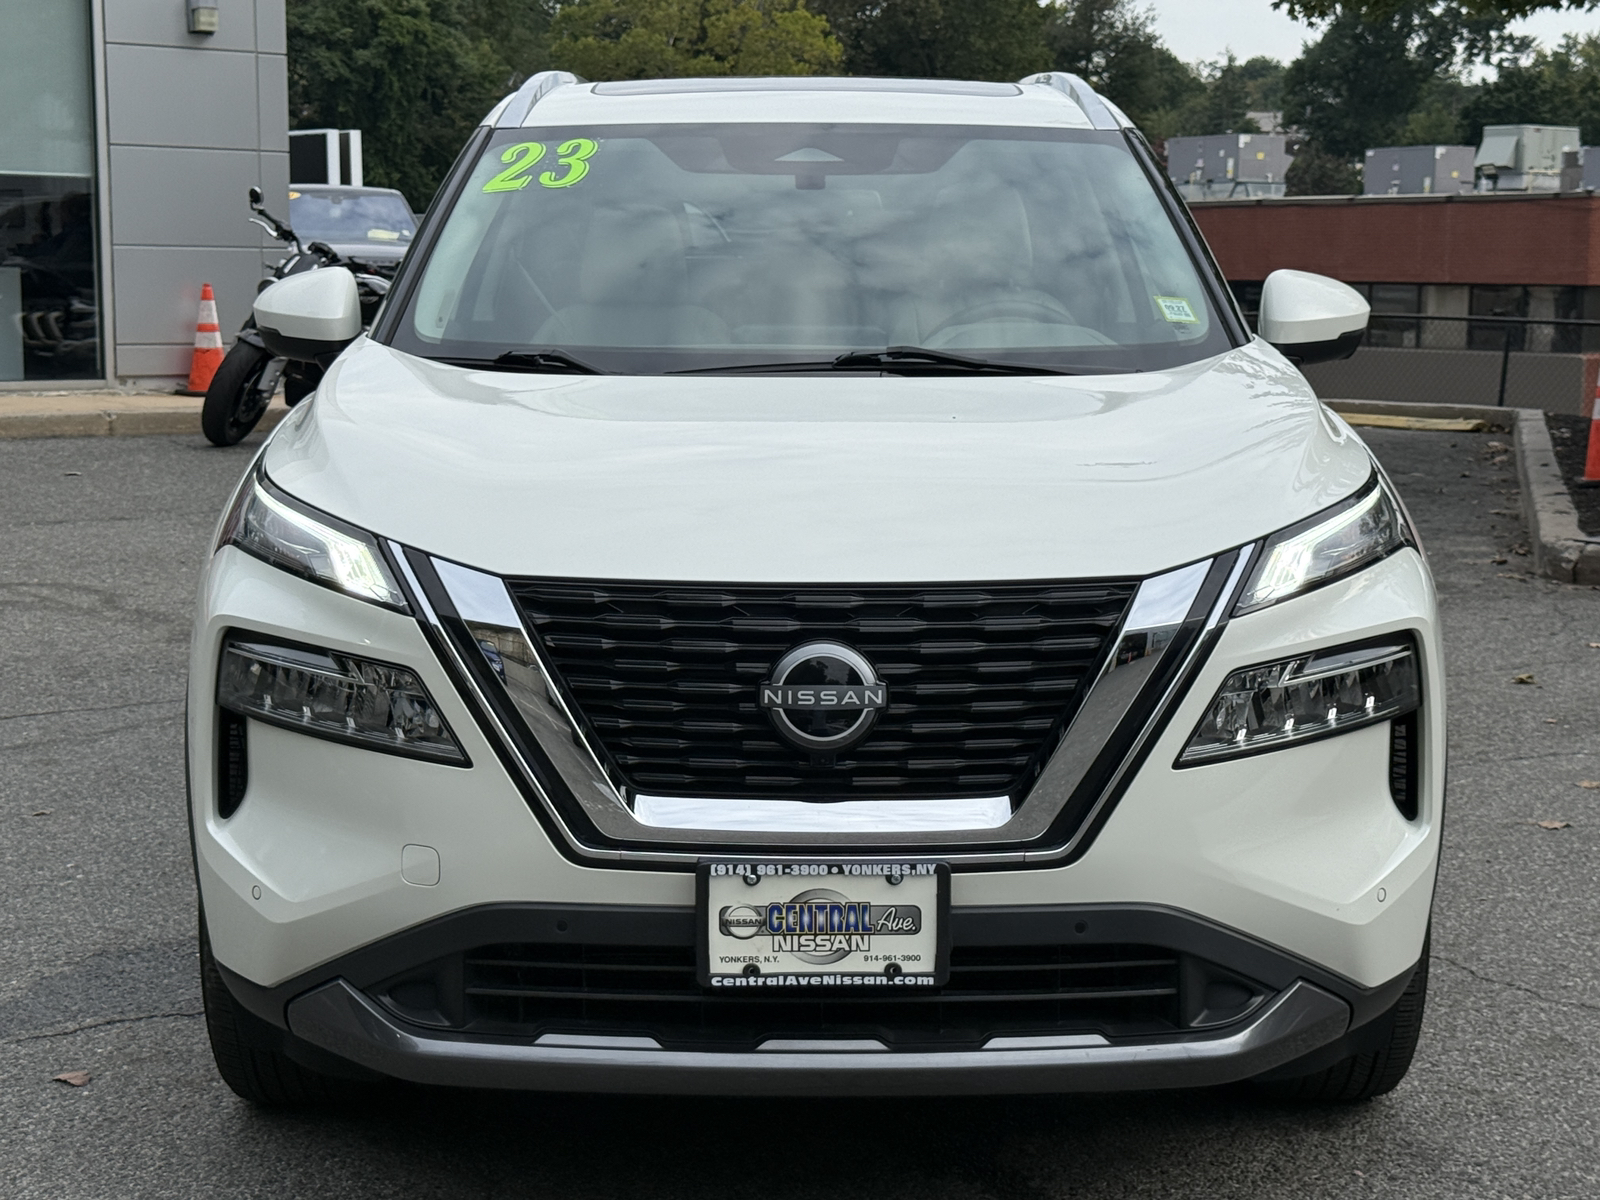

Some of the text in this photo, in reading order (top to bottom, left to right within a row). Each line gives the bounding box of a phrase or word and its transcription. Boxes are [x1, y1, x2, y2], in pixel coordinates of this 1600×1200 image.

[482, 138, 598, 193] 23
[764, 689, 882, 705] NISSAN
[757, 864, 828, 875] 961-3900
[767, 903, 917, 934] CENTRAL Ave.
[773, 935, 870, 952] NISSAN
[719, 955, 780, 964] YONKERS, N.Y.
[863, 954, 922, 962] 914-961-3900
